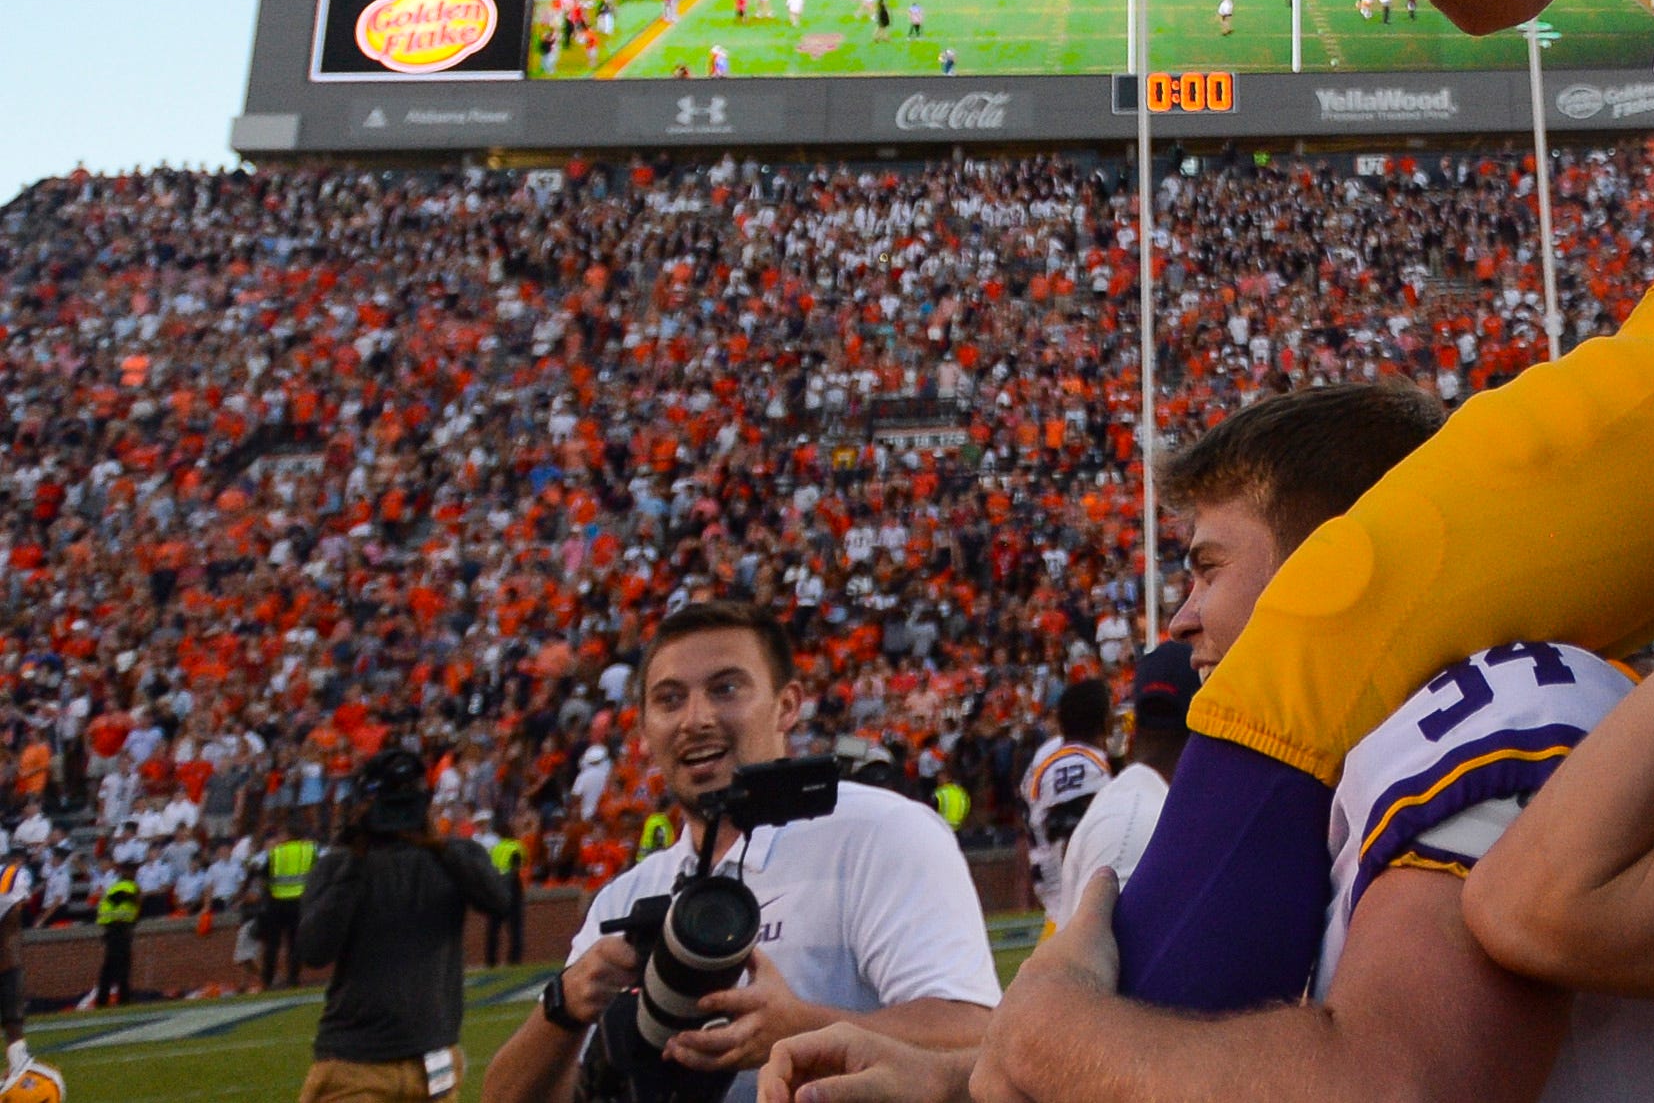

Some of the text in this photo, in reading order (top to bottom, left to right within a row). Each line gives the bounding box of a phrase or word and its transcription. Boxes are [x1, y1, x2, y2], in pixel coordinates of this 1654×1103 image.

[370, 0, 484, 32] Golden
[382, 24, 477, 56] Flake
[1147, 71, 1233, 113] 0:00
[1417, 641, 1576, 743] 34
[1054, 764, 1085, 795] 22
